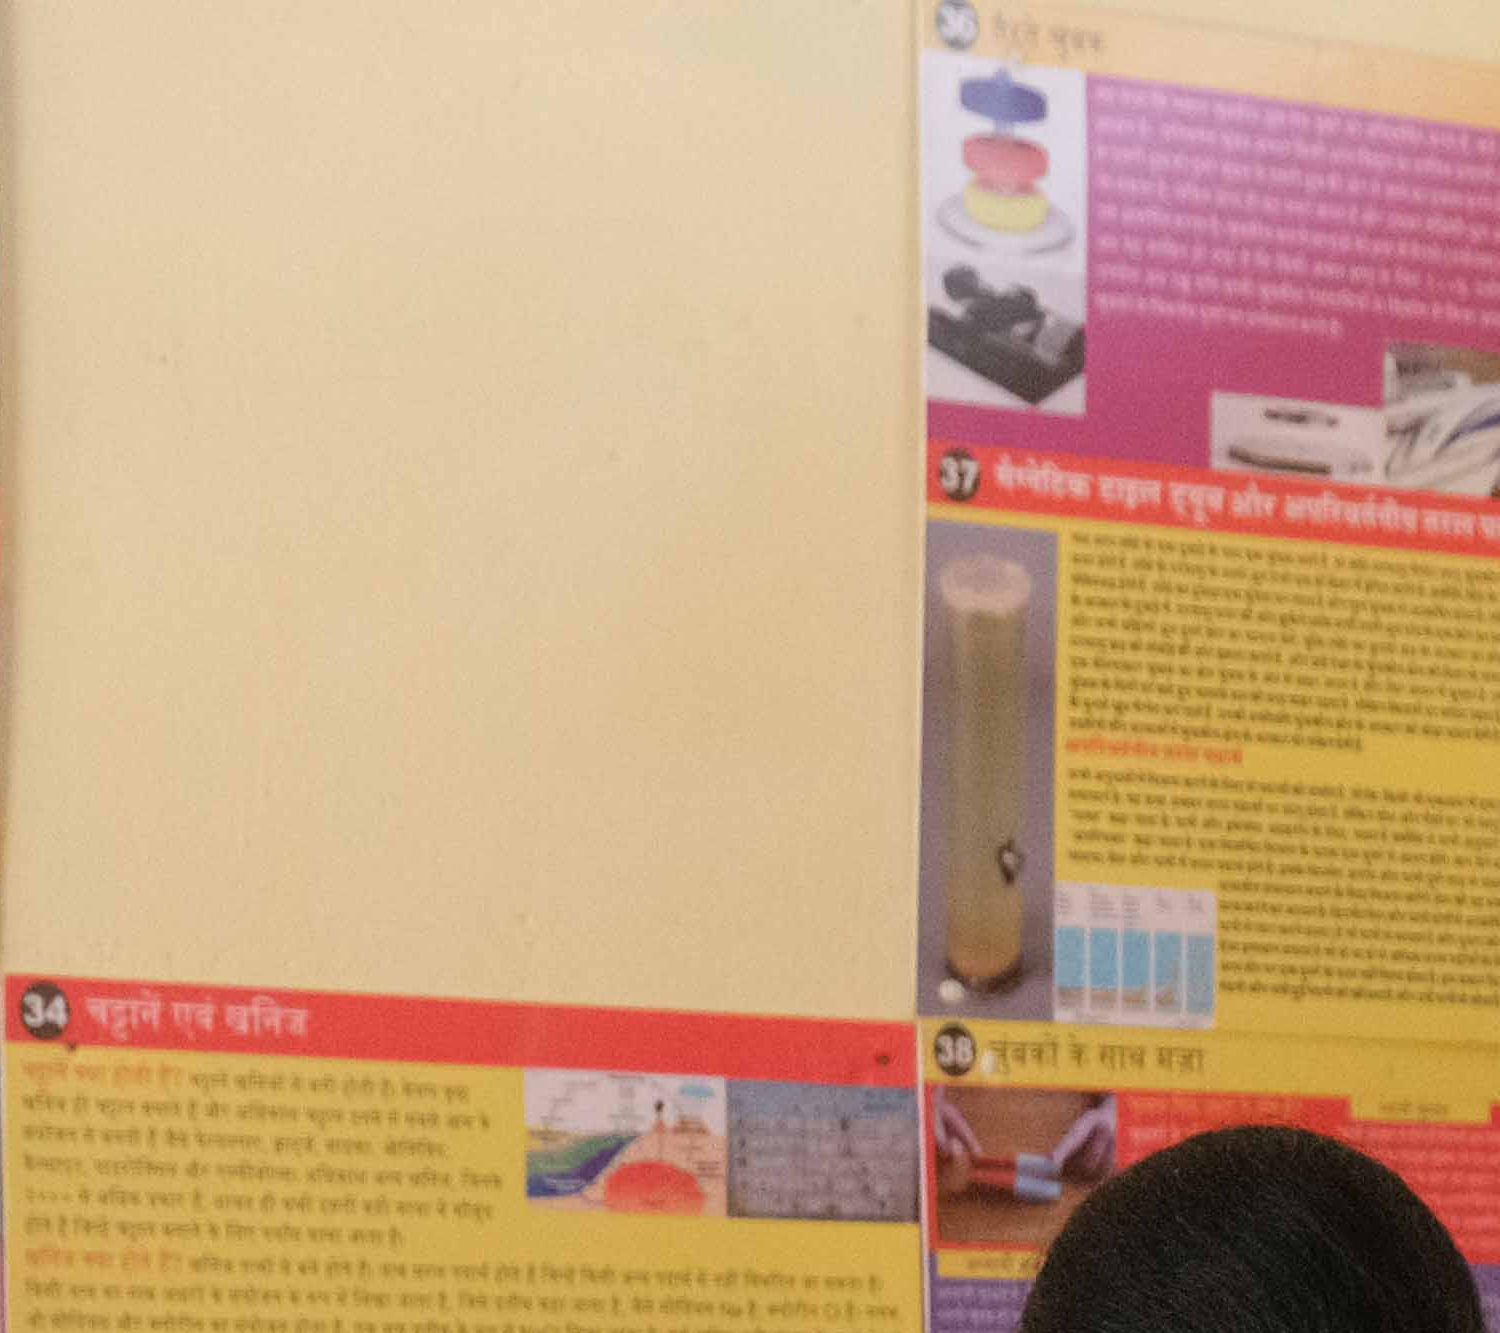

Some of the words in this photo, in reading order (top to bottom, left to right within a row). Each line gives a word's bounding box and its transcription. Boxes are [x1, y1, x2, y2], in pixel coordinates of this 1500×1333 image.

[941, 457, 978, 494] 37
[23, 994, 67, 1028] 34
[937, 1034, 974, 1067] 38
